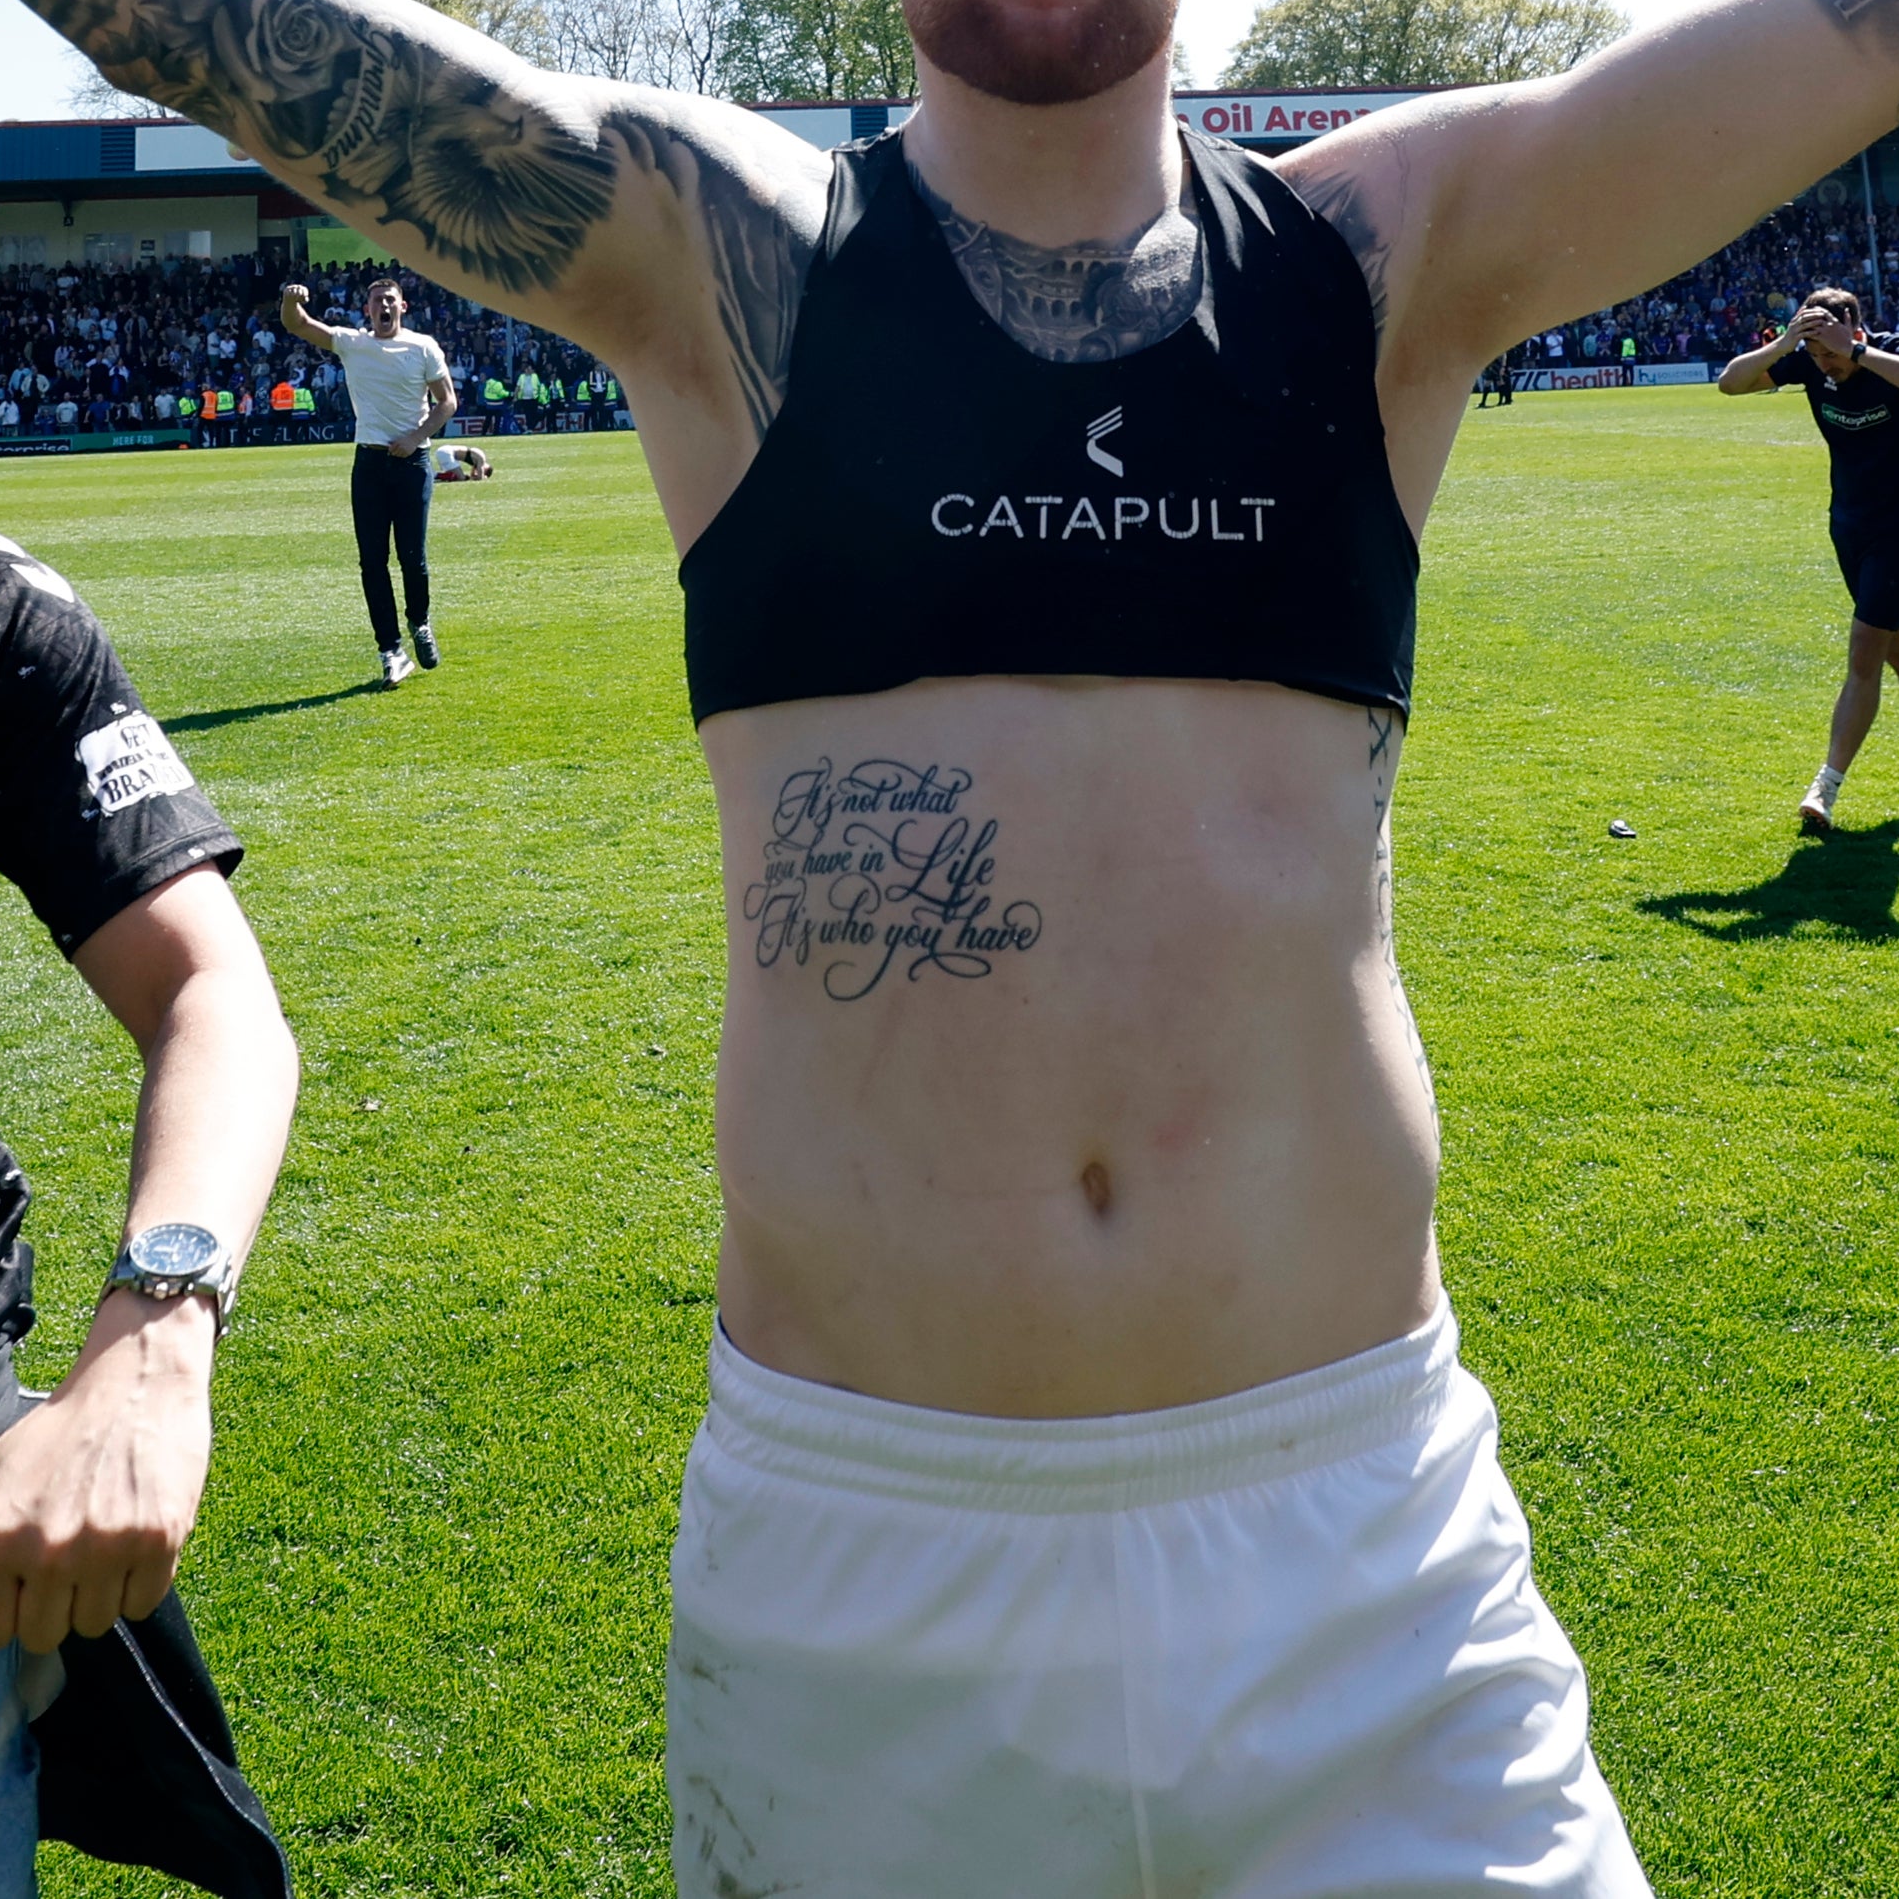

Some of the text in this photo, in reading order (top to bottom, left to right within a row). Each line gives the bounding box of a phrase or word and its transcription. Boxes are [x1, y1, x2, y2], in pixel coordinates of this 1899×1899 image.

[323, 14, 401, 169] Grandma
[1202, 102, 1372, 133] Oil Aren
[136, 434, 154, 445] FOR
[931, 493, 1276, 542] CATAPULT
[889, 762, 972, 814] what
[859, 844, 886, 873] in
[882, 818, 998, 924] Life
[819, 882, 881, 944] who
[954, 895, 1042, 952] have
